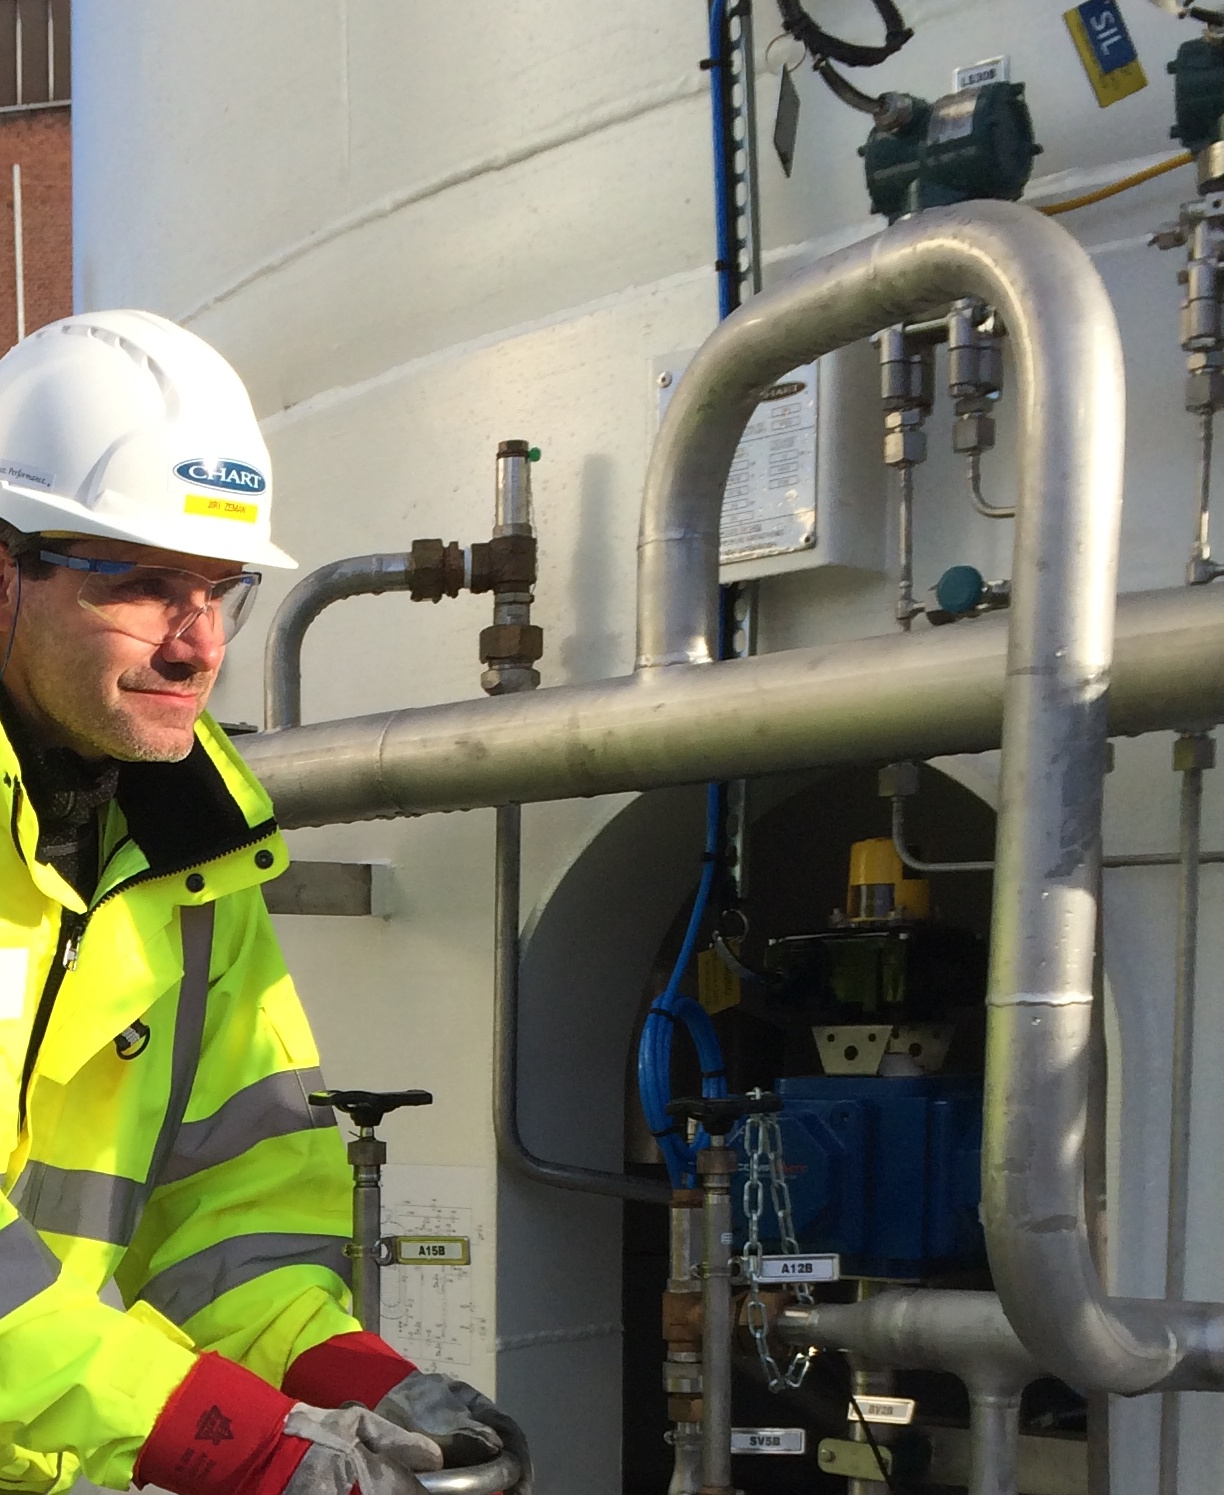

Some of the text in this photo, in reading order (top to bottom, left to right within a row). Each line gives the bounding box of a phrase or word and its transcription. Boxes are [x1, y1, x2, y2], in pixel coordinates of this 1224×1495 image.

[1089, 10, 1122, 56] SIL
[188, 465, 262, 489] CHART
[418, 1245, 446, 1257] A15B
[781, 1262, 813, 1275] A12B
[749, 1436, 781, 1447] SV5B
